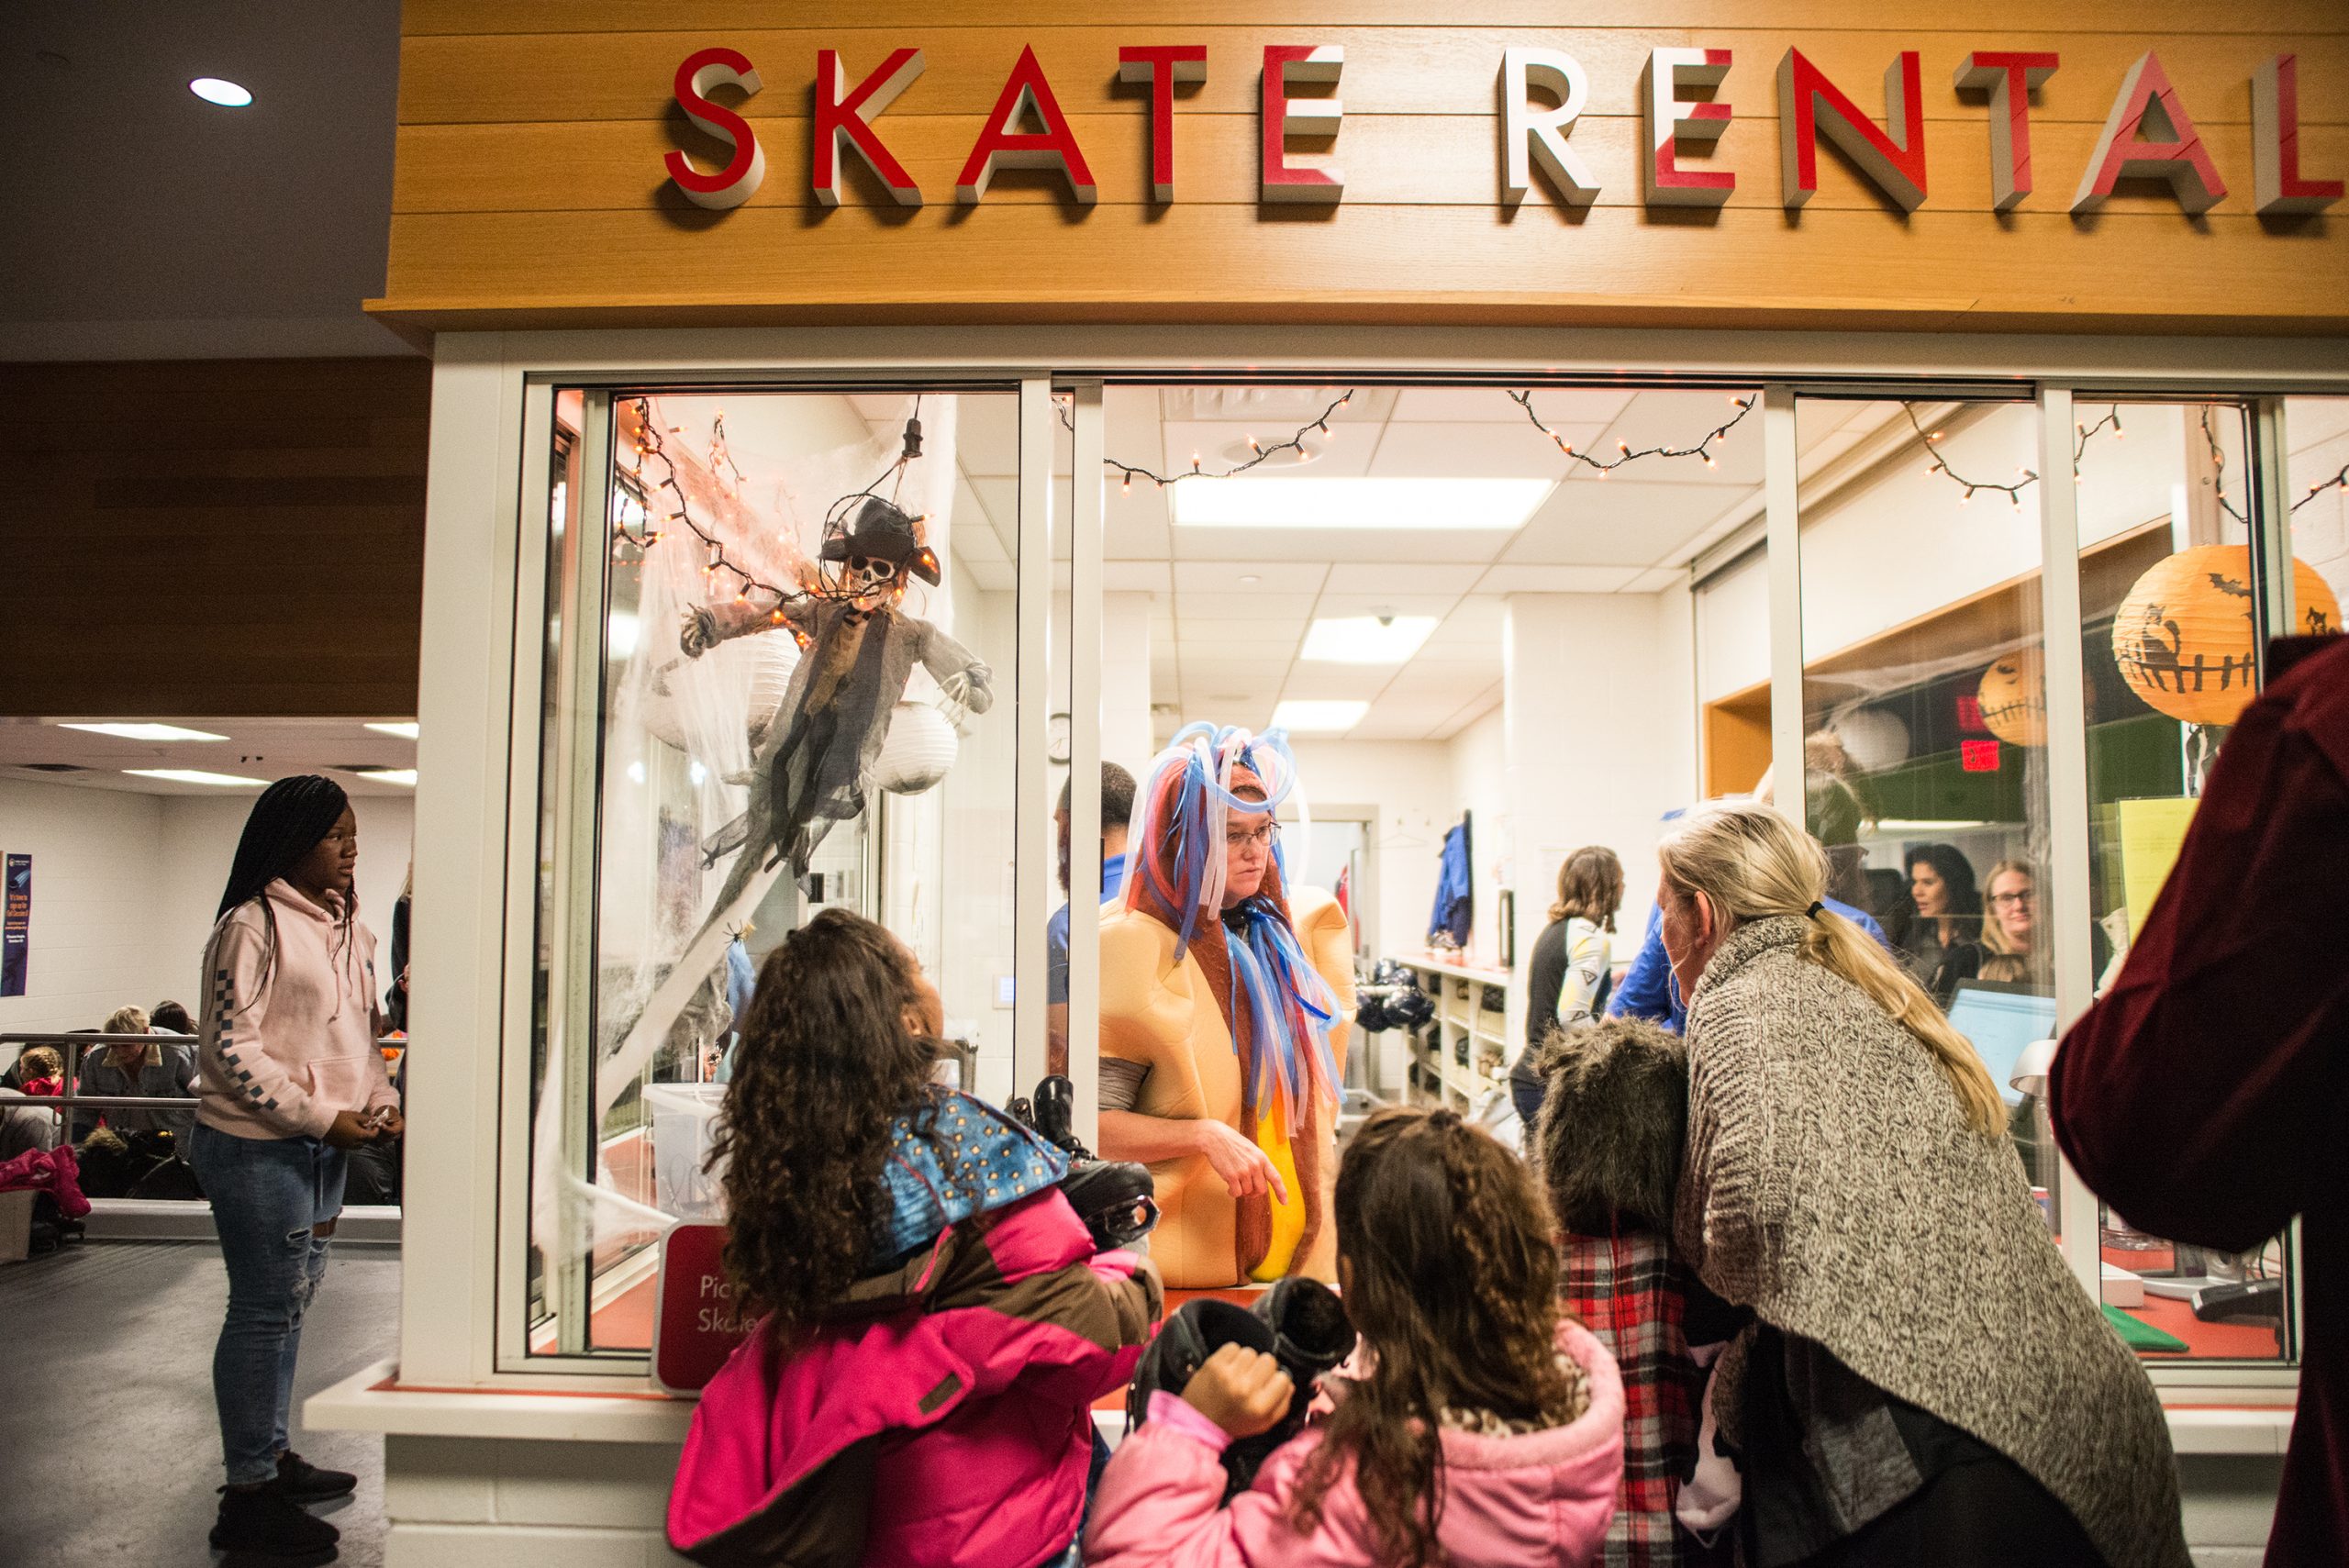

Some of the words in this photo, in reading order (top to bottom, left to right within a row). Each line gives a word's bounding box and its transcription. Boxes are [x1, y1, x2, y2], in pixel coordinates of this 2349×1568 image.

[664, 43, 1343, 209] SKATE
[1497, 45, 2345, 213] RENTAL
[699, 1274, 731, 1298] Pic
